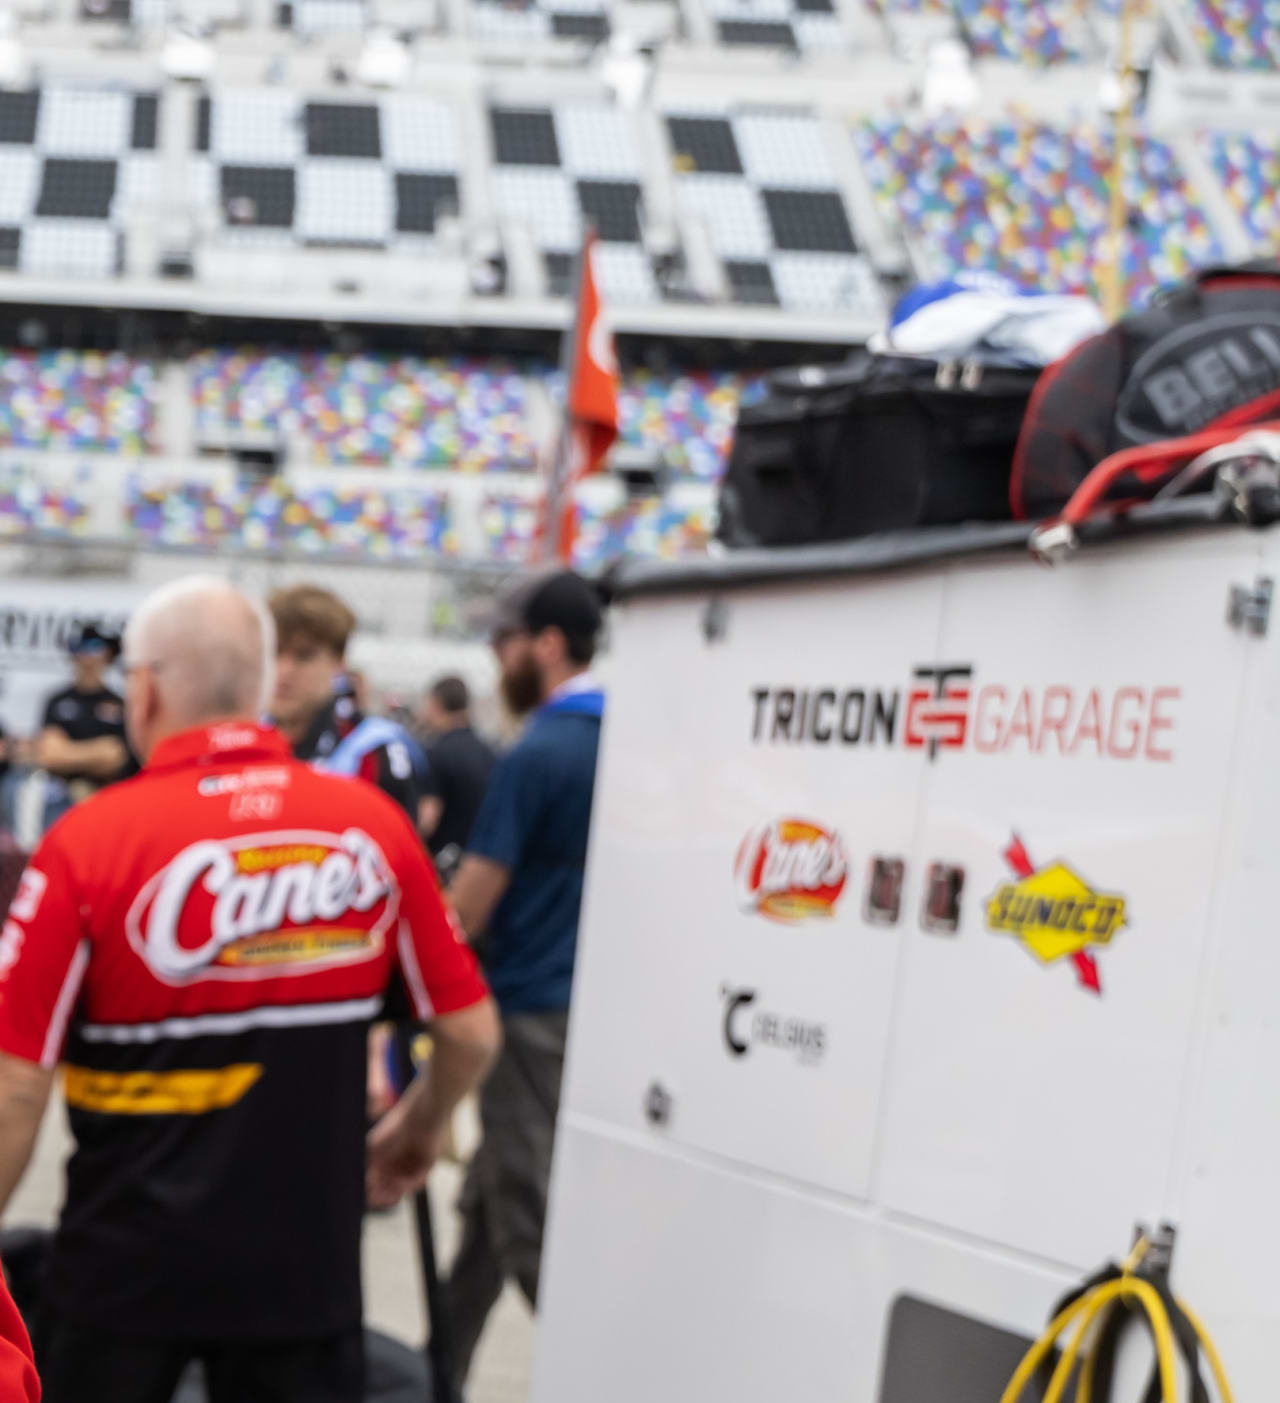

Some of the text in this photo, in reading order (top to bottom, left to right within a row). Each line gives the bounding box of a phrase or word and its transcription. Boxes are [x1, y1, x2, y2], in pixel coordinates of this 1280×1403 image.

[751, 686, 900, 744] TRICON
[973, 685, 1181, 762] GARAGE
[146, 829, 392, 976] Cane's
